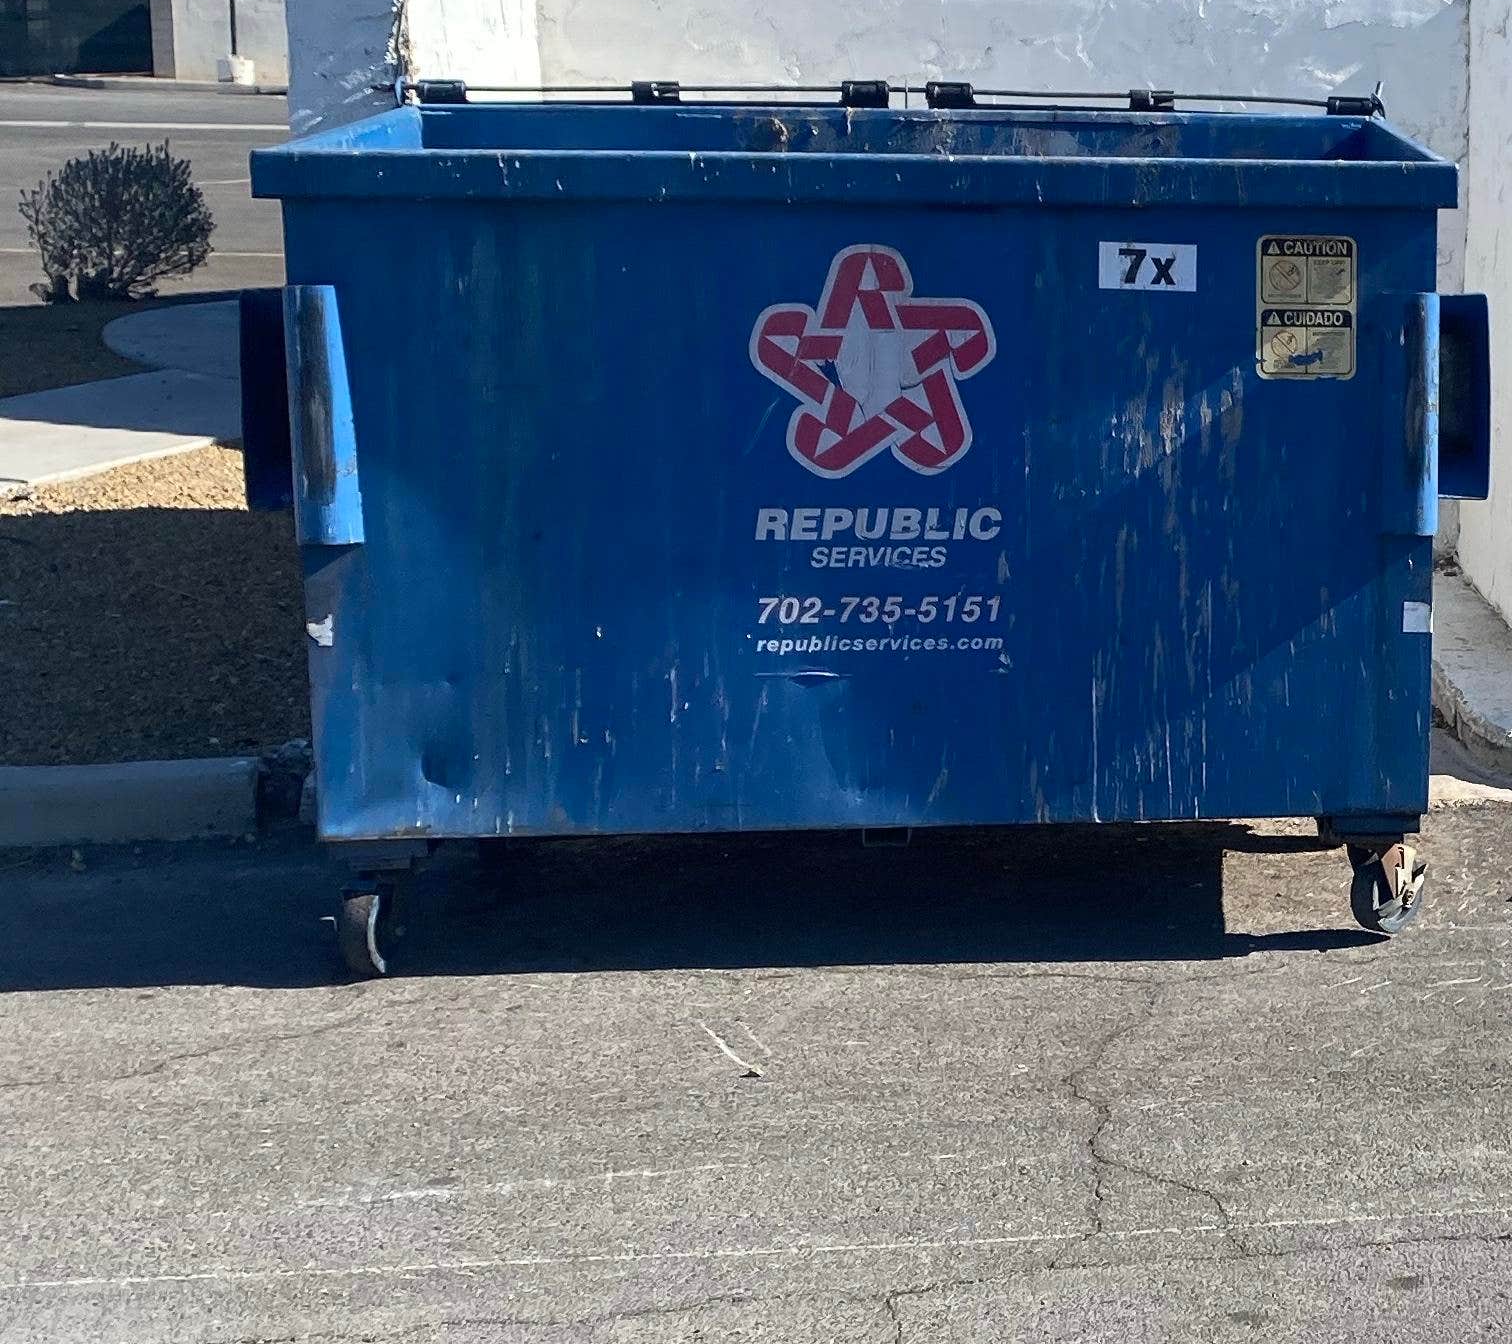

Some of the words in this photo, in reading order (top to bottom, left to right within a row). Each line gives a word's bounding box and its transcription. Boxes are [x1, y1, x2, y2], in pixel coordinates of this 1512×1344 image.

[1283, 241, 1348, 255] CAUTION
[1284, 311, 1344, 326] CUIDADO
[754, 507, 1002, 541] REPUBLIC
[810, 546, 948, 569] SERVICES
[758, 596, 1001, 624] 702-735-5151
[756, 634, 1004, 655] republicservices.com
